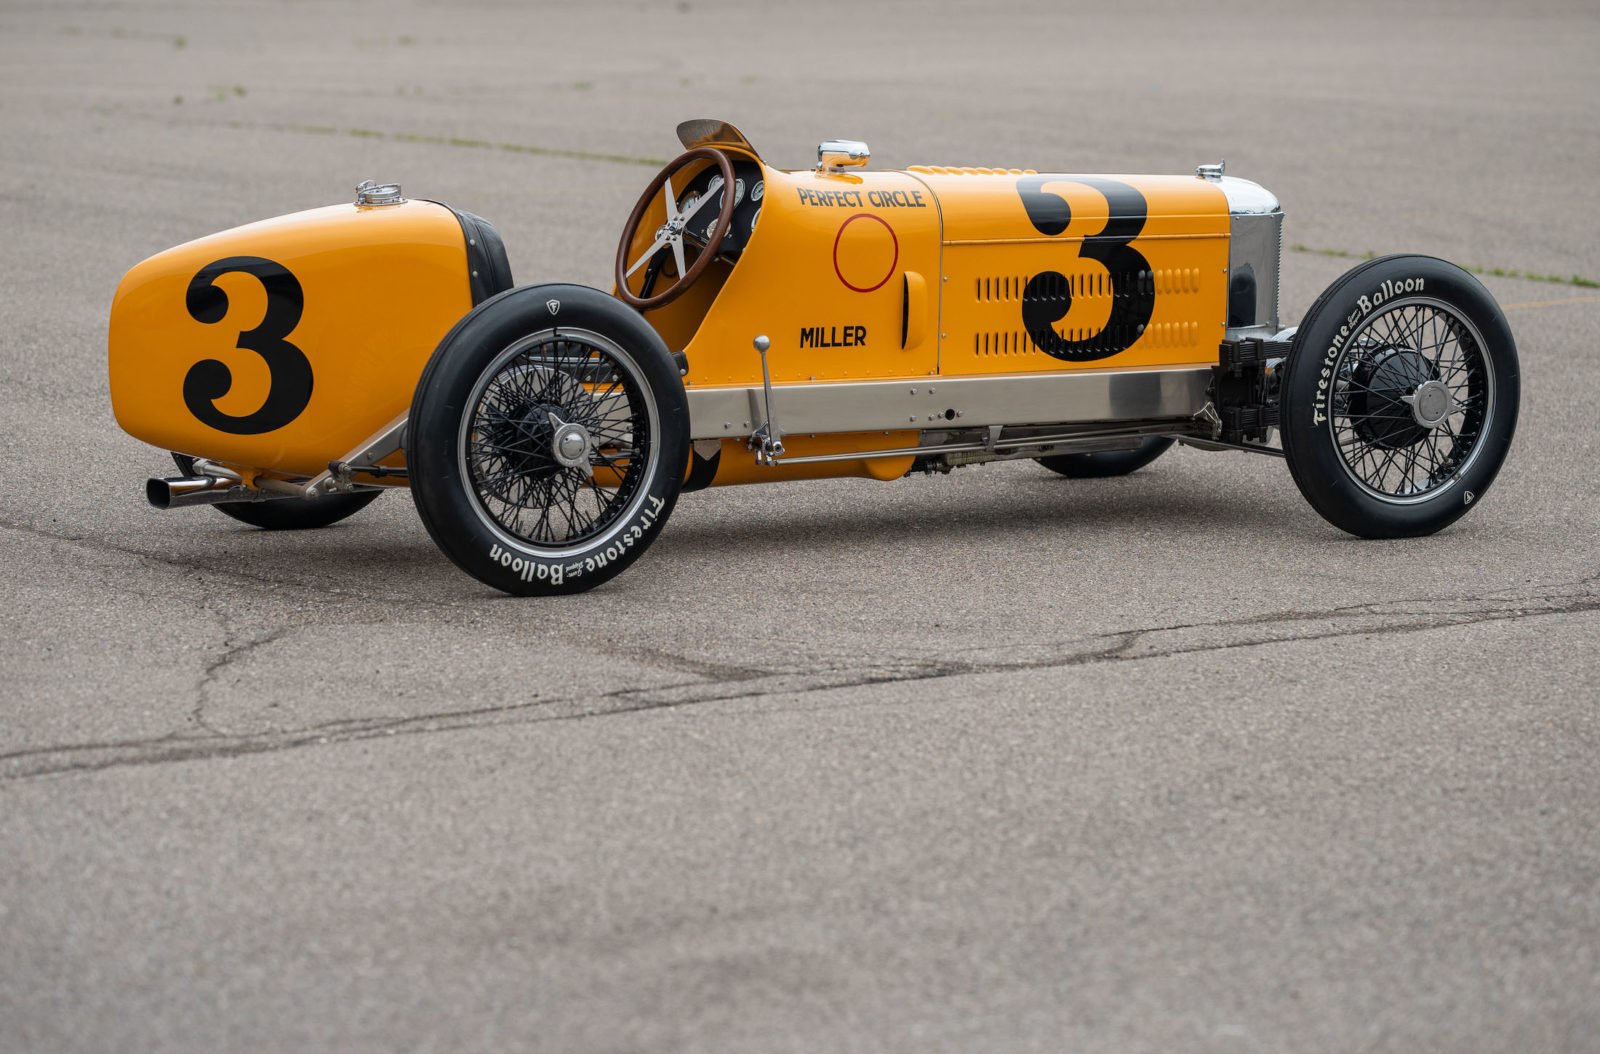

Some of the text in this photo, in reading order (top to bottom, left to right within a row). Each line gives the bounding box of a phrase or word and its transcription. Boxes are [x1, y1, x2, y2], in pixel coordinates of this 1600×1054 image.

[796, 187, 926, 207] PERFECT CIRCLE
[1016, 174, 1155, 362] 3
[183, 255, 314, 435] 3
[800, 326, 866, 348] MILLER
[1313, 277, 1425, 427] Firestone Balloon
[489, 494, 665, 585] Firestone Balloon
